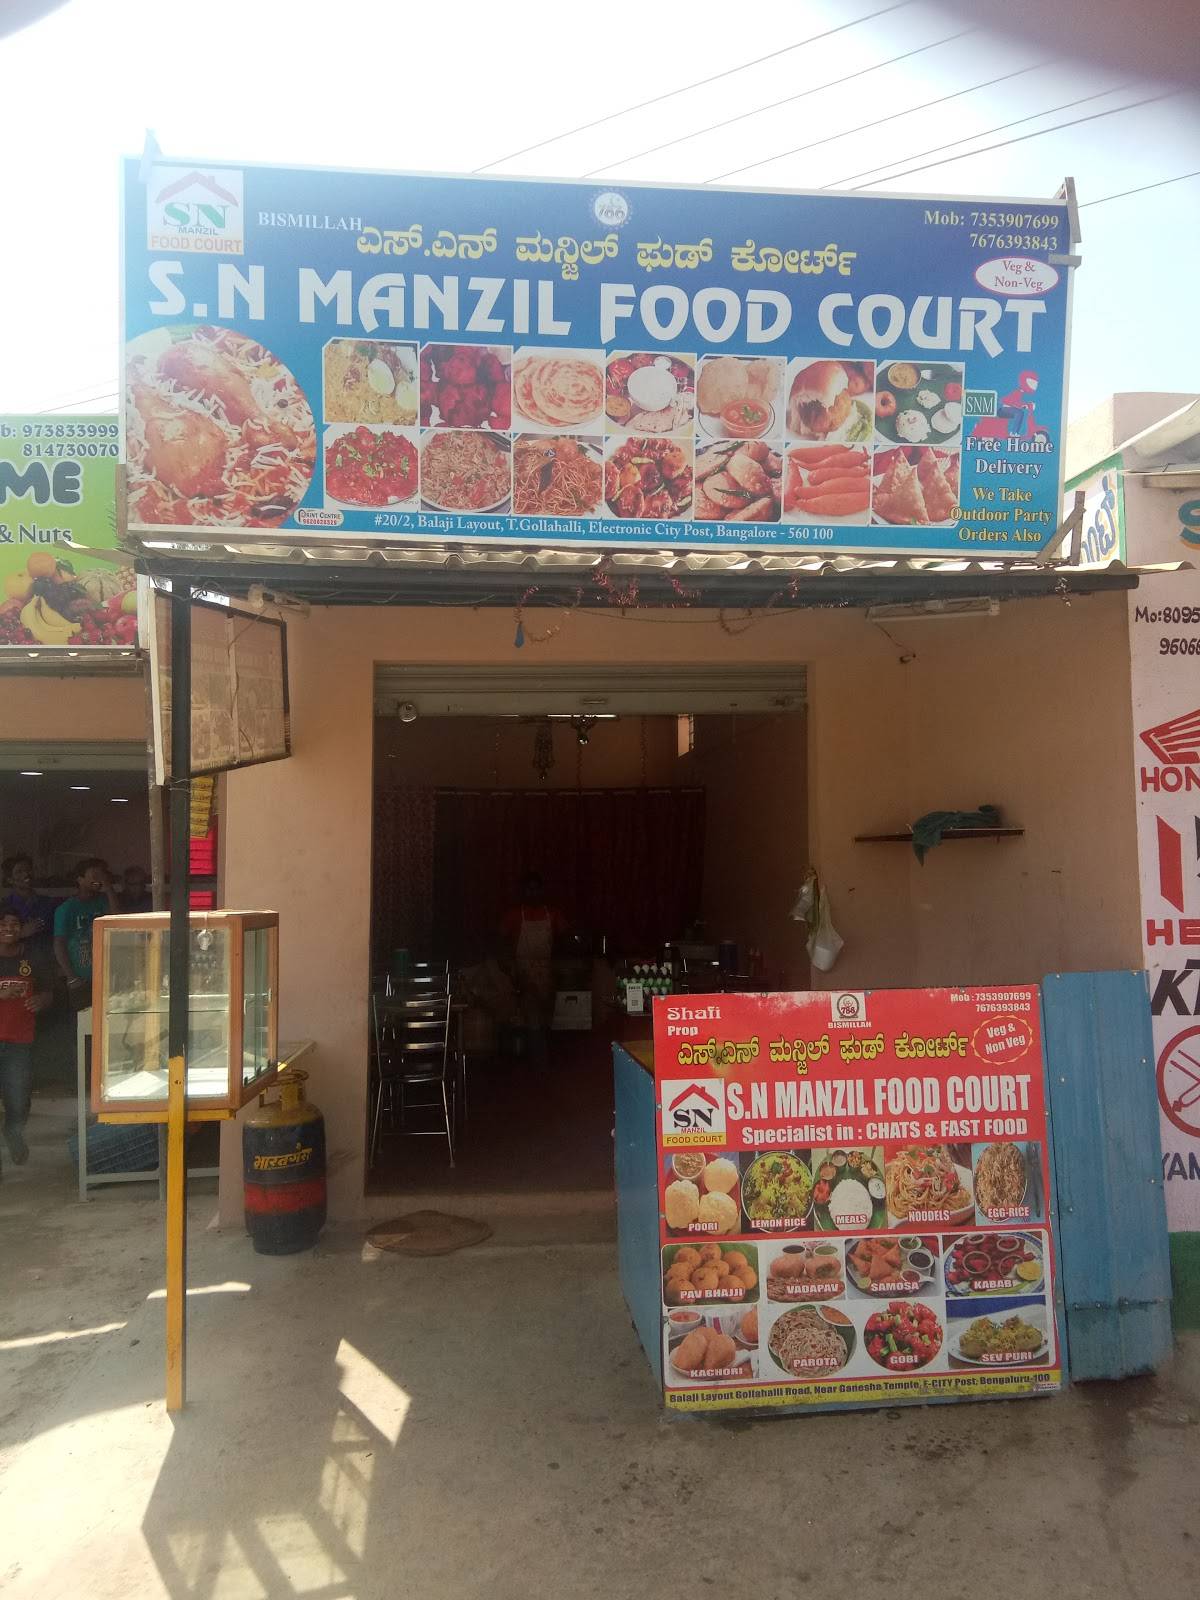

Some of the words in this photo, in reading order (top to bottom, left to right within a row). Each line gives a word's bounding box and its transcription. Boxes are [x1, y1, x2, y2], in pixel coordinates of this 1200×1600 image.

[163, 202, 230, 229] SN
[258, 212, 362, 232] BISMILLAH
[924, 210, 964, 226] Mob:
[969, 212, 1059, 229] 7353907699
[178, 226, 218, 236] MANZIL
[151, 235, 190, 250] FOOD
[194, 237, 242, 253] COURT
[969, 233, 1058, 251] 7676393843
[1003, 260, 1022, 275] Veg
[1024, 262, 1036, 273] &
[994, 276, 1044, 291] Non-Veg
[148, 260, 265, 321] S.N
[298, 267, 572, 336] MANZIL
[600, 282, 792, 344] FOOD
[818, 292, 1047, 359] COURT
[966, 396, 994, 414] SNM
[966, 437, 1001, 452] Free
[1007, 437, 1054, 453] Home
[976, 459, 1042, 478] Delivery
[972, 487, 995, 501] We
[999, 487, 1033, 501] Take
[950, 506, 1010, 521] Outdoor
[1014, 508, 1052, 526] Party
[19, 524, 73, 543] Nuts
[374, 514, 415, 530] #20/2,
[417, 515, 451, 533] Balaji
[456, 516, 504, 534] Layout,
[588, 522, 652, 536] Electronic
[654, 523, 681, 539] City
[683, 524, 714, 539] Post,
[716, 525, 777, 541] Bangalore
[787, 527, 810, 540] 560
[812, 528, 834, 541] 100
[959, 527, 1008, 542] Orders
[1011, 528, 1042, 543] Also
[950, 993, 970, 1002] Mob
[667, 1006, 721, 1021] Shafi
[975, 1003, 1031, 1012] 7676393843
[667, 1025, 699, 1037] Prop
[828, 1021, 872, 1029] BISMILLAH
[986, 1025, 1006, 1038] Veg
[1007, 1023, 1016, 1032] &
[985, 1041, 1006, 1055] Non
[1005, 1035, 1026, 1048] Veg
[727, 1082, 768, 1121] S.N
[775, 1079, 869, 1119] MANZIL
[873, 1077, 941, 1116] FOOD
[946, 1074, 1031, 1113] COURT
[673, 1108, 713, 1128] SN
[742, 1125, 833, 1145] Specialist
[836, 1124, 854, 1141] in
[866, 1121, 920, 1140] CHATS
[924, 1122, 937, 1137] &
[940, 1119, 980, 1137] FAST
[984, 1118, 1028, 1136] FOOD
[666, 1136, 692, 1144] FOOD
[693, 1135, 723, 1143] COURT
[836, 1214, 867, 1224] MEALS
[987, 1206, 1030, 1218] EGG-RICE
[688, 1222, 718, 1231] POORI
[751, 1219, 783, 1228] LEMON
[784, 1218, 807, 1227] RICE
[786, 1283, 839, 1294] VADAPAV
[871, 1281, 920, 1291] SAMOSA
[974, 1279, 1012, 1289] KABAB
[680, 1290, 702, 1299] PAV
[793, 1357, 838, 1368] PAROTA
[890, 1355, 918, 1364] GOBI
[982, 1353, 1003, 1362] SEV
[1005, 1352, 1032, 1361] PURI
[690, 1367, 743, 1378] KACHORI
[670, 1393, 699, 1403] Balaji
[701, 1391, 734, 1402] Layout
[735, 1388, 783, 1399] Gollahalli
[814, 1385, 838, 1394] Near
[839, 1383, 882, 1393] Ganesha
